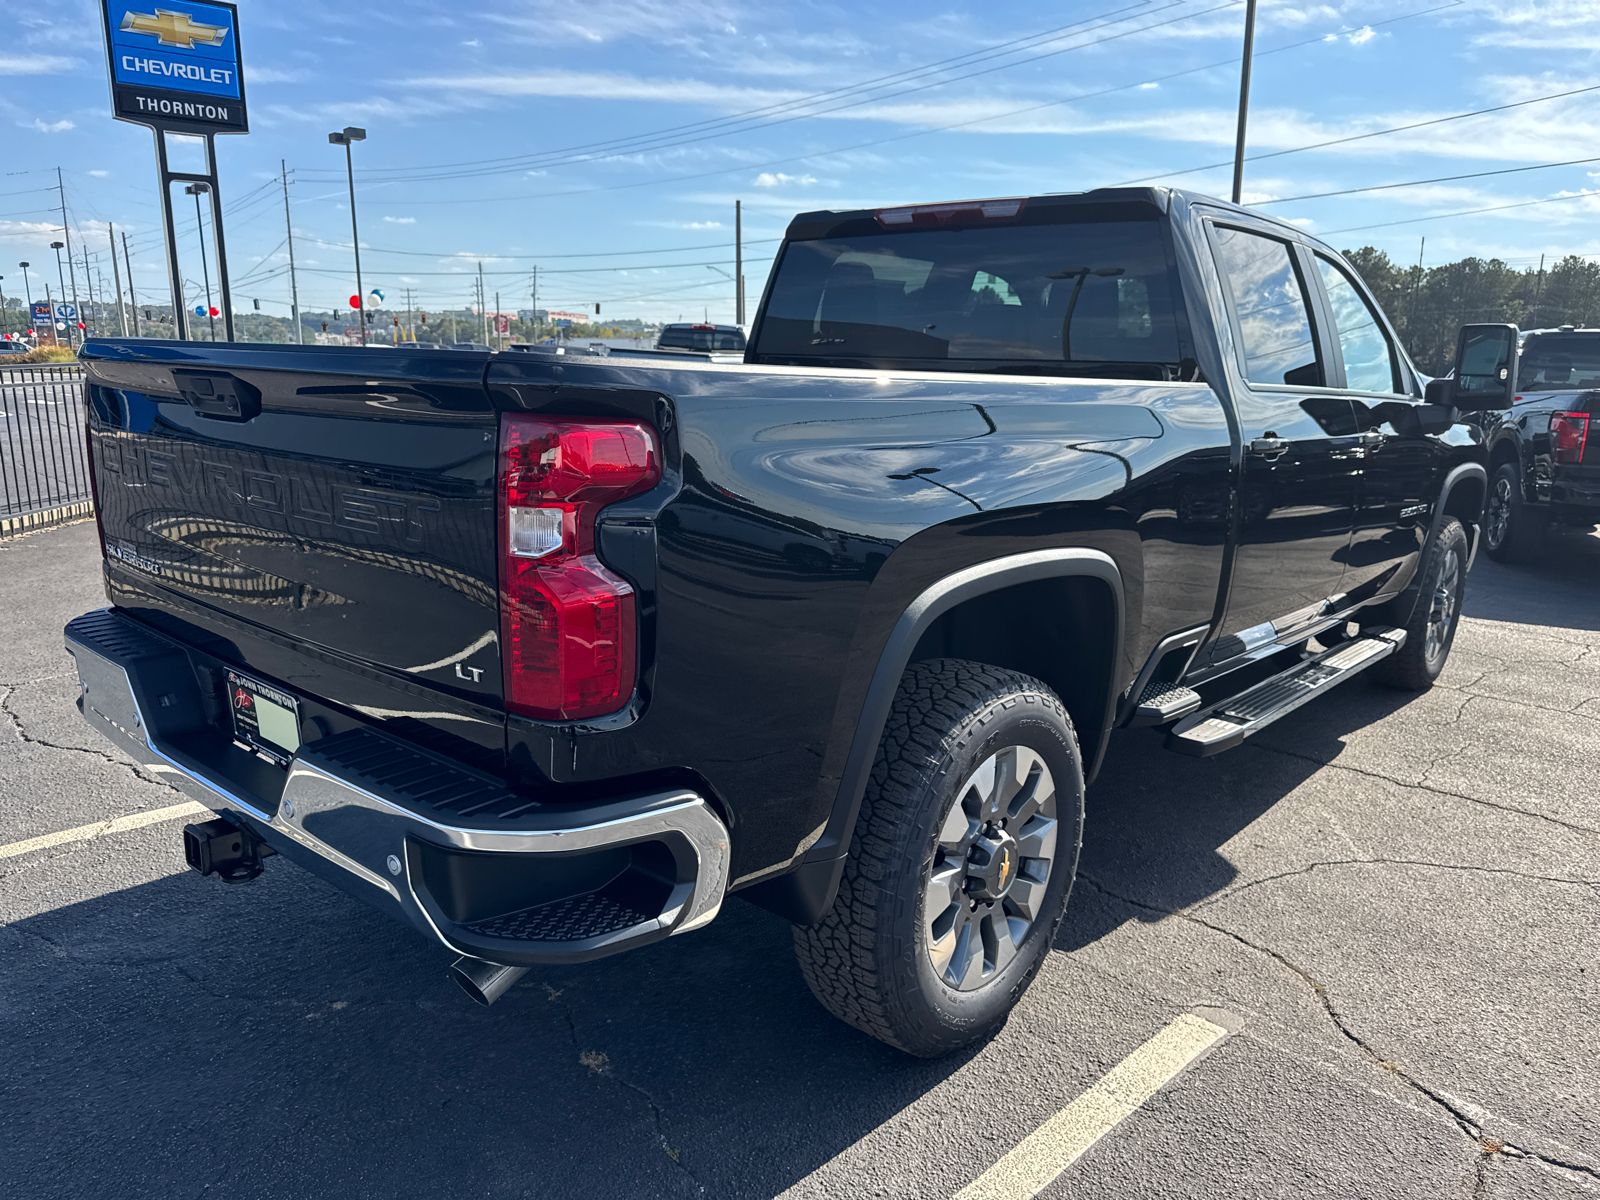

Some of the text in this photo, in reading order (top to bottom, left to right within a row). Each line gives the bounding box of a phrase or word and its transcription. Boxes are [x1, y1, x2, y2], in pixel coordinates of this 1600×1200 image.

[122, 55, 233, 84] CHEVROLET
[136, 96, 229, 120] THORNTON
[100, 438, 441, 543] CHEVROLET
[455, 662, 485, 683] LT
